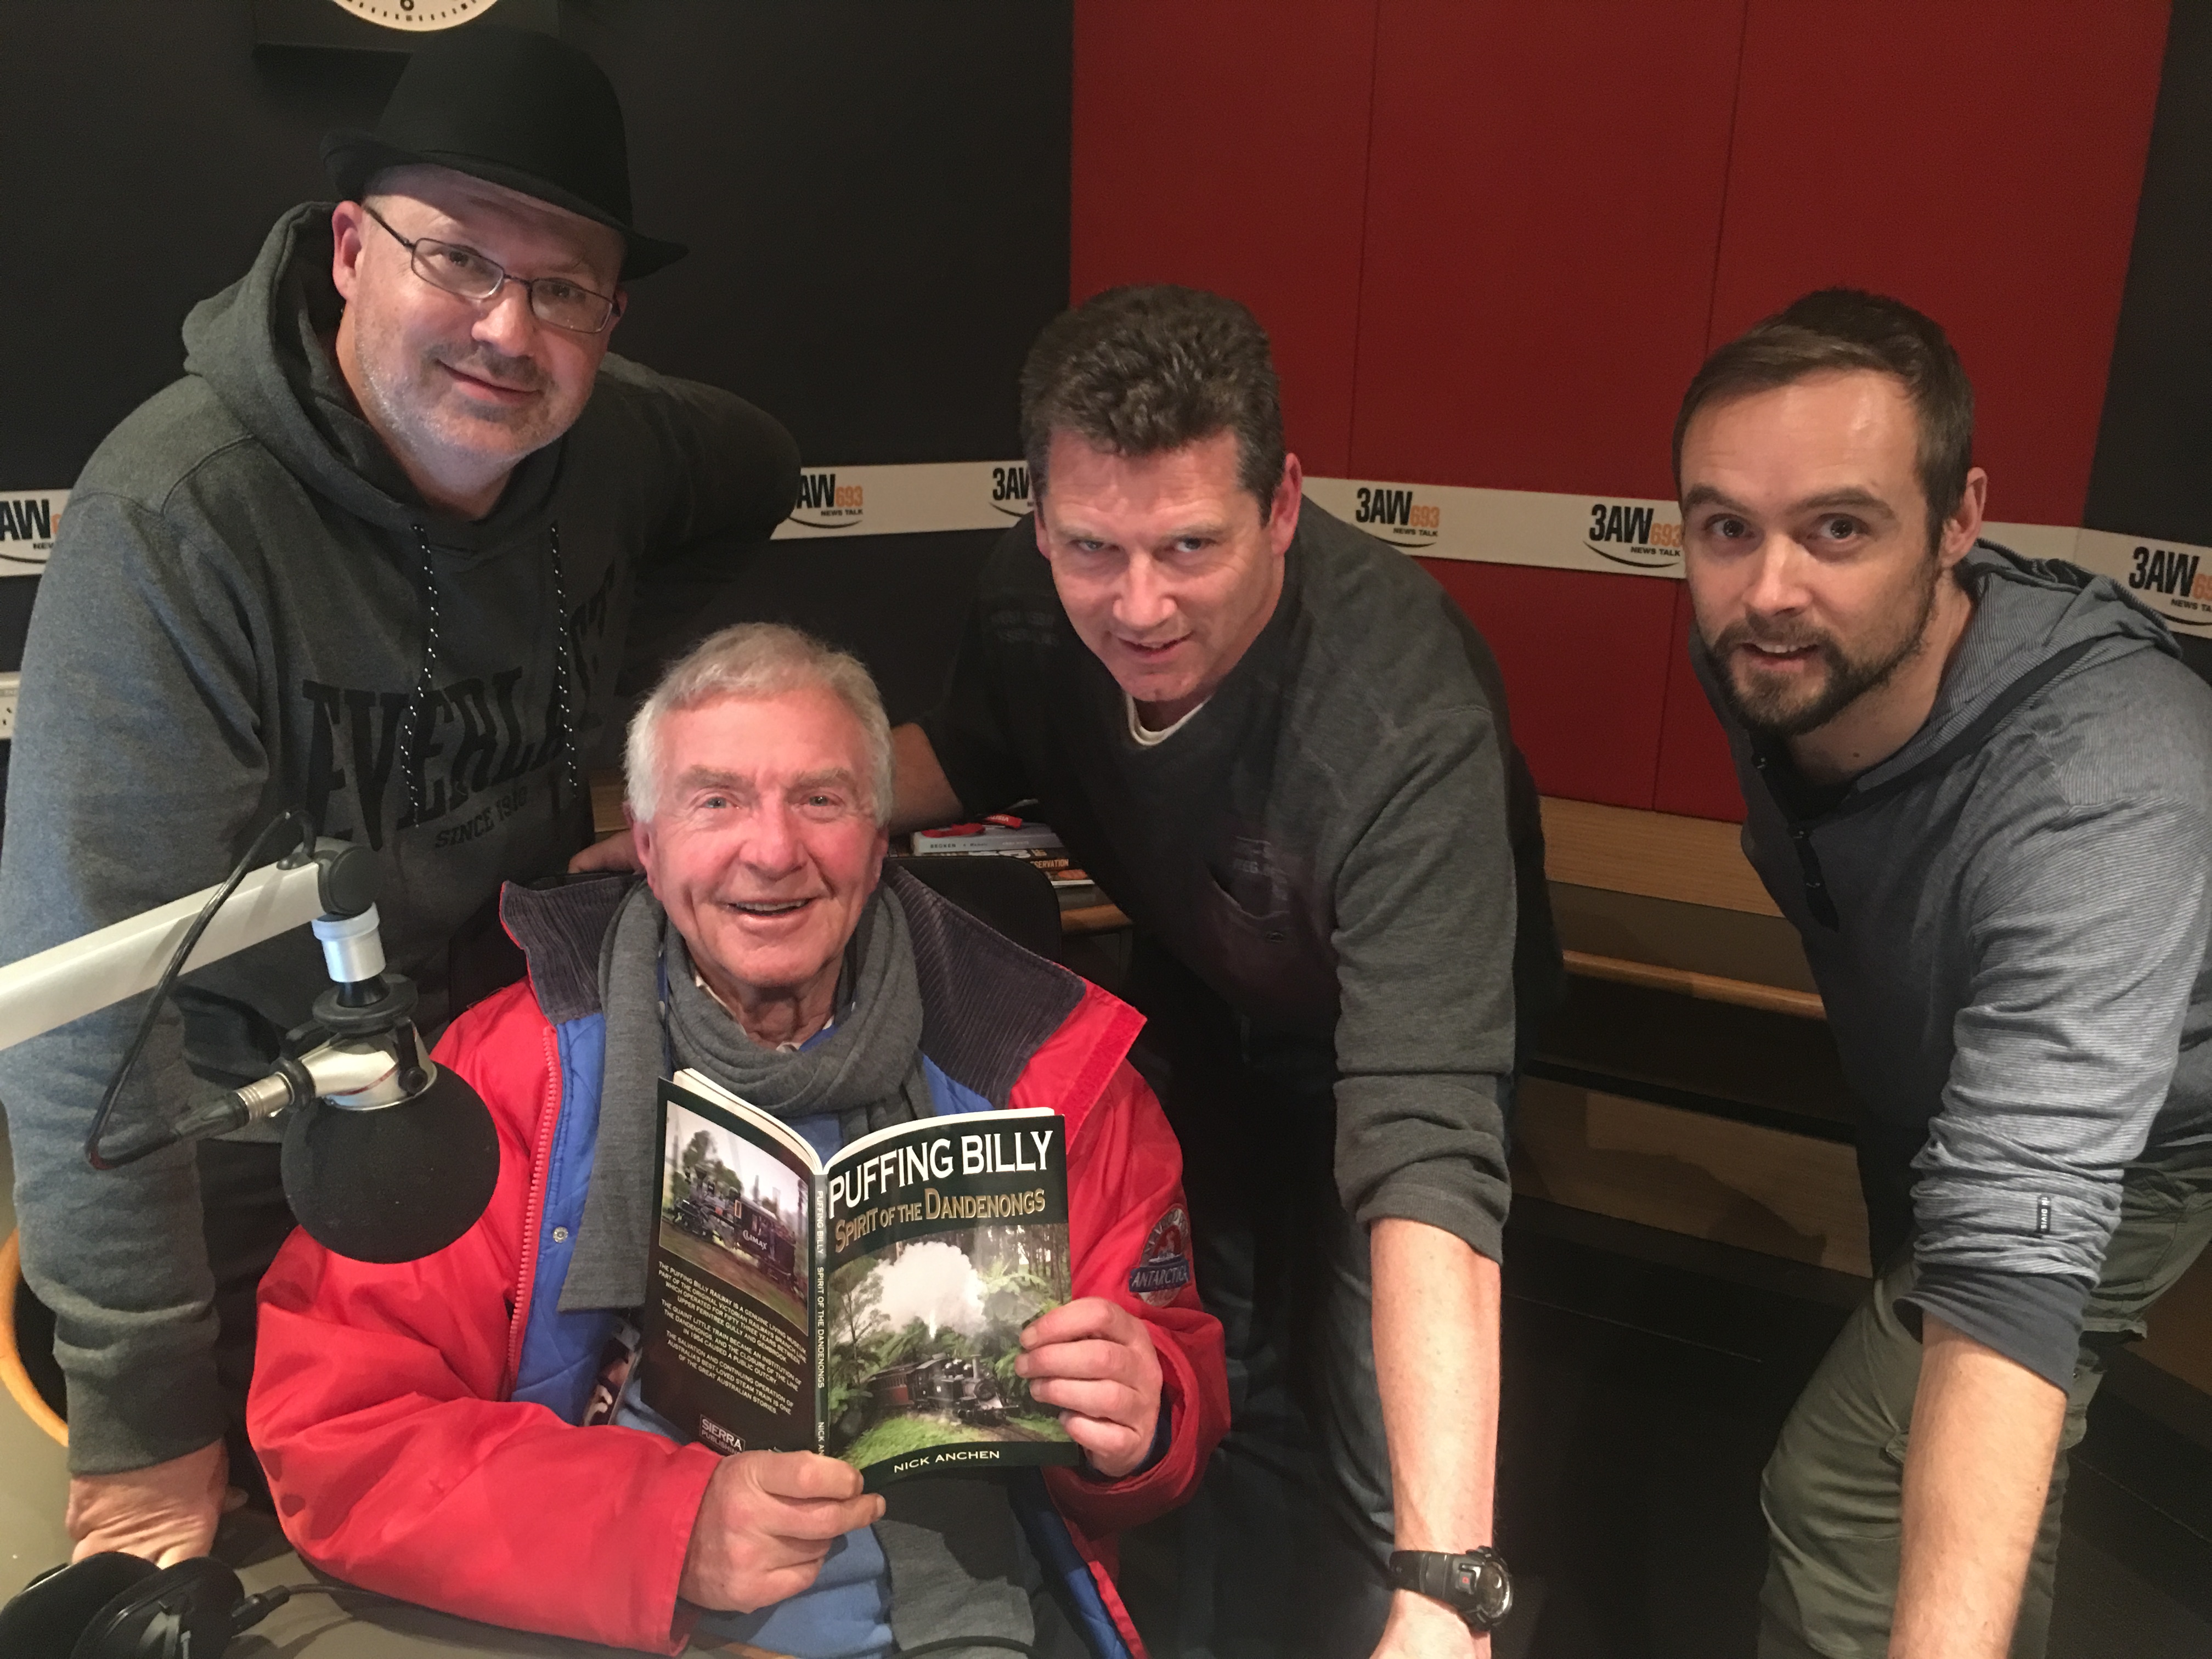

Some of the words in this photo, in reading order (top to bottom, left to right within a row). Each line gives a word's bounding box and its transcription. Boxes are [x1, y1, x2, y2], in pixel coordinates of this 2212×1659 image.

[795, 474, 836, 509] AW
[836, 486, 863, 507] 693
[1356, 488, 1413, 526] 3AW
[1409, 506, 1440, 528] 693
[1393, 527, 1416, 537] NEWS
[1418, 529, 1438, 537] TALK
[1589, 504, 1654, 545] 3AW
[1651, 523, 1682, 547] 693
[1630, 546, 1656, 555] NEWS
[1658, 549, 1681, 557] TALK
[2129, 546, 2200, 597] 3AW
[2192, 573, 2212, 601] 69
[2170, 598, 2198, 610] NEWS
[2201, 603, 2212, 612] TA
[435, 806, 495, 848] SINCE
[1030, 859, 1069, 868] SERVATION
[828, 1138, 954, 1219] PUFFING
[961, 1130, 1053, 1175] BILLY
[835, 1207, 878, 1252] SPIRIT
[879, 1206, 895, 1228] OF
[896, 1202, 923, 1223] THE
[924, 1187, 1046, 1220] DANDENONGS
[659, 1261, 669, 1272] THE
[670, 1267, 693, 1284] PUFFING
[693, 1280, 708, 1292] BILLY
[709, 1289, 732, 1305] RAILWAY
[744, 1309, 769, 1327] GENUINE
[769, 1323, 786, 1339] LIVING
[659, 1270, 672, 1280] PART
[681, 1282, 691, 1293] THE
[692, 1289, 718, 1306] ORIGINAL
[719, 1302, 748, 1323] VICTORIAN
[748, 1319, 774, 1339] RAILWAYS
[665, 1281, 683, 1295] WHICH
[683, 1291, 712, 1310] OPERATED
[712, 1306, 724, 1317] FOR
[724, 1312, 740, 1325] FIFTY
[740, 1322, 758, 1336] THREE
[759, 1333, 776, 1348] YEARS
[677, 1295, 696, 1310] UPPER
[696, 1306, 725, 1327] FERNTREE
[725, 1322, 743, 1336] GULLY
[744, 1333, 757, 1344] AND
[817, 1296, 825, 1308] OF
[662, 1298, 672, 1310] THE
[673, 1306, 692, 1321] QUAINT
[693, 1317, 712, 1331] LITTLE
[712, 1327, 729, 1341] TRAIN
[730, 1337, 752, 1355] BECAME
[753, 1351, 761, 1359] AN
[762, 1356, 795, 1381] INSTITUTION
[664, 1308, 674, 1319] THE
[714, 1338, 727, 1348] AND
[728, 1344, 739, 1355] THE
[740, 1351, 766, 1371] CLOSURE
[766, 1366, 774, 1374] OF
[775, 1371, 786, 1383] THE
[704, 1340, 727, 1356] CAUSED
[733, 1355, 753, 1372] PUBLIC
[667, 1330, 677, 1341] THE
[678, 1337, 706, 1357] SALVATION
[706, 1353, 719, 1364] AND
[719, 1361, 754, 1384] CONTINUING
[754, 1380, 786, 1403] OPERATION
[687, 1358, 697, 1370] THE
[698, 1365, 716, 1379] GREAT
[716, 1376, 752, 1400] AUSTRALIAN
[735, 1378, 754, 1393] STEAM
[755, 1389, 772, 1403] TRAIN
[779, 1403, 791, 1415] ONE
[701, 1429, 739, 1455] PUBLISHIN
[702, 1418, 742, 1452] SIERRA
[894, 1456, 930, 1474] NICK
[935, 1451, 1000, 1463] ANCHEN
